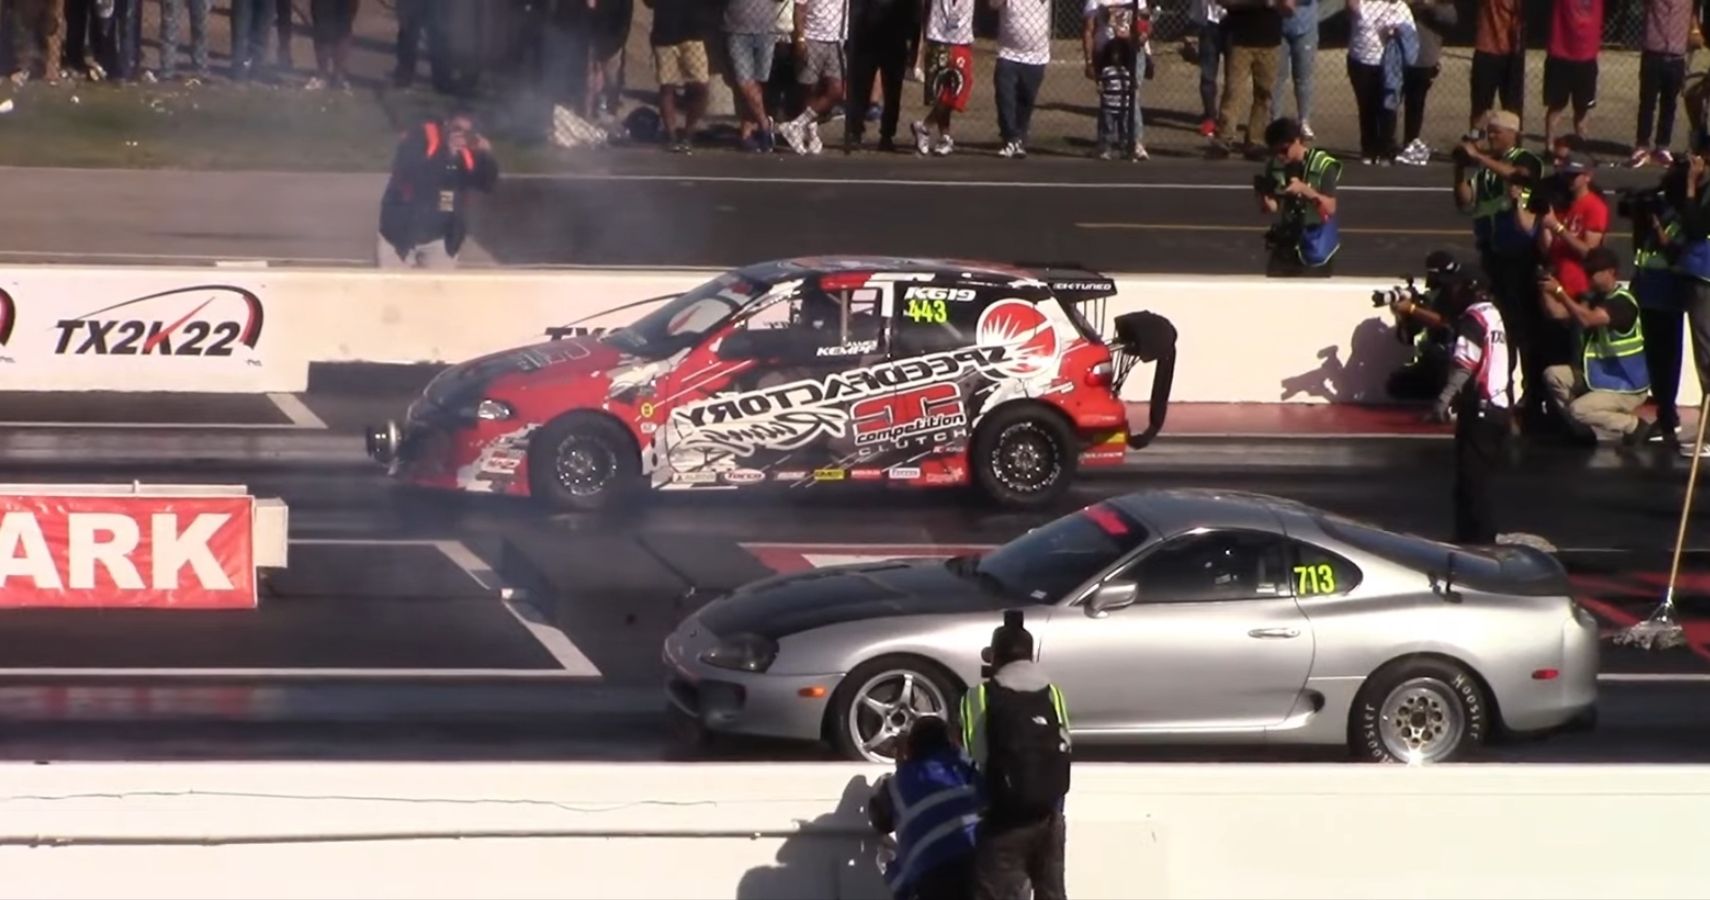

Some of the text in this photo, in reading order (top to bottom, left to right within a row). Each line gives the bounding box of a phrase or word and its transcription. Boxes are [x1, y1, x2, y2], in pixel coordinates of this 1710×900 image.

[908, 299, 947, 323] 443
[55, 319, 241, 356] TX2K22
[857, 413, 966, 444] competition
[858, 428, 968, 456] CLUTCH
[0, 511, 235, 592] ARK
[1294, 564, 1335, 594] 713
